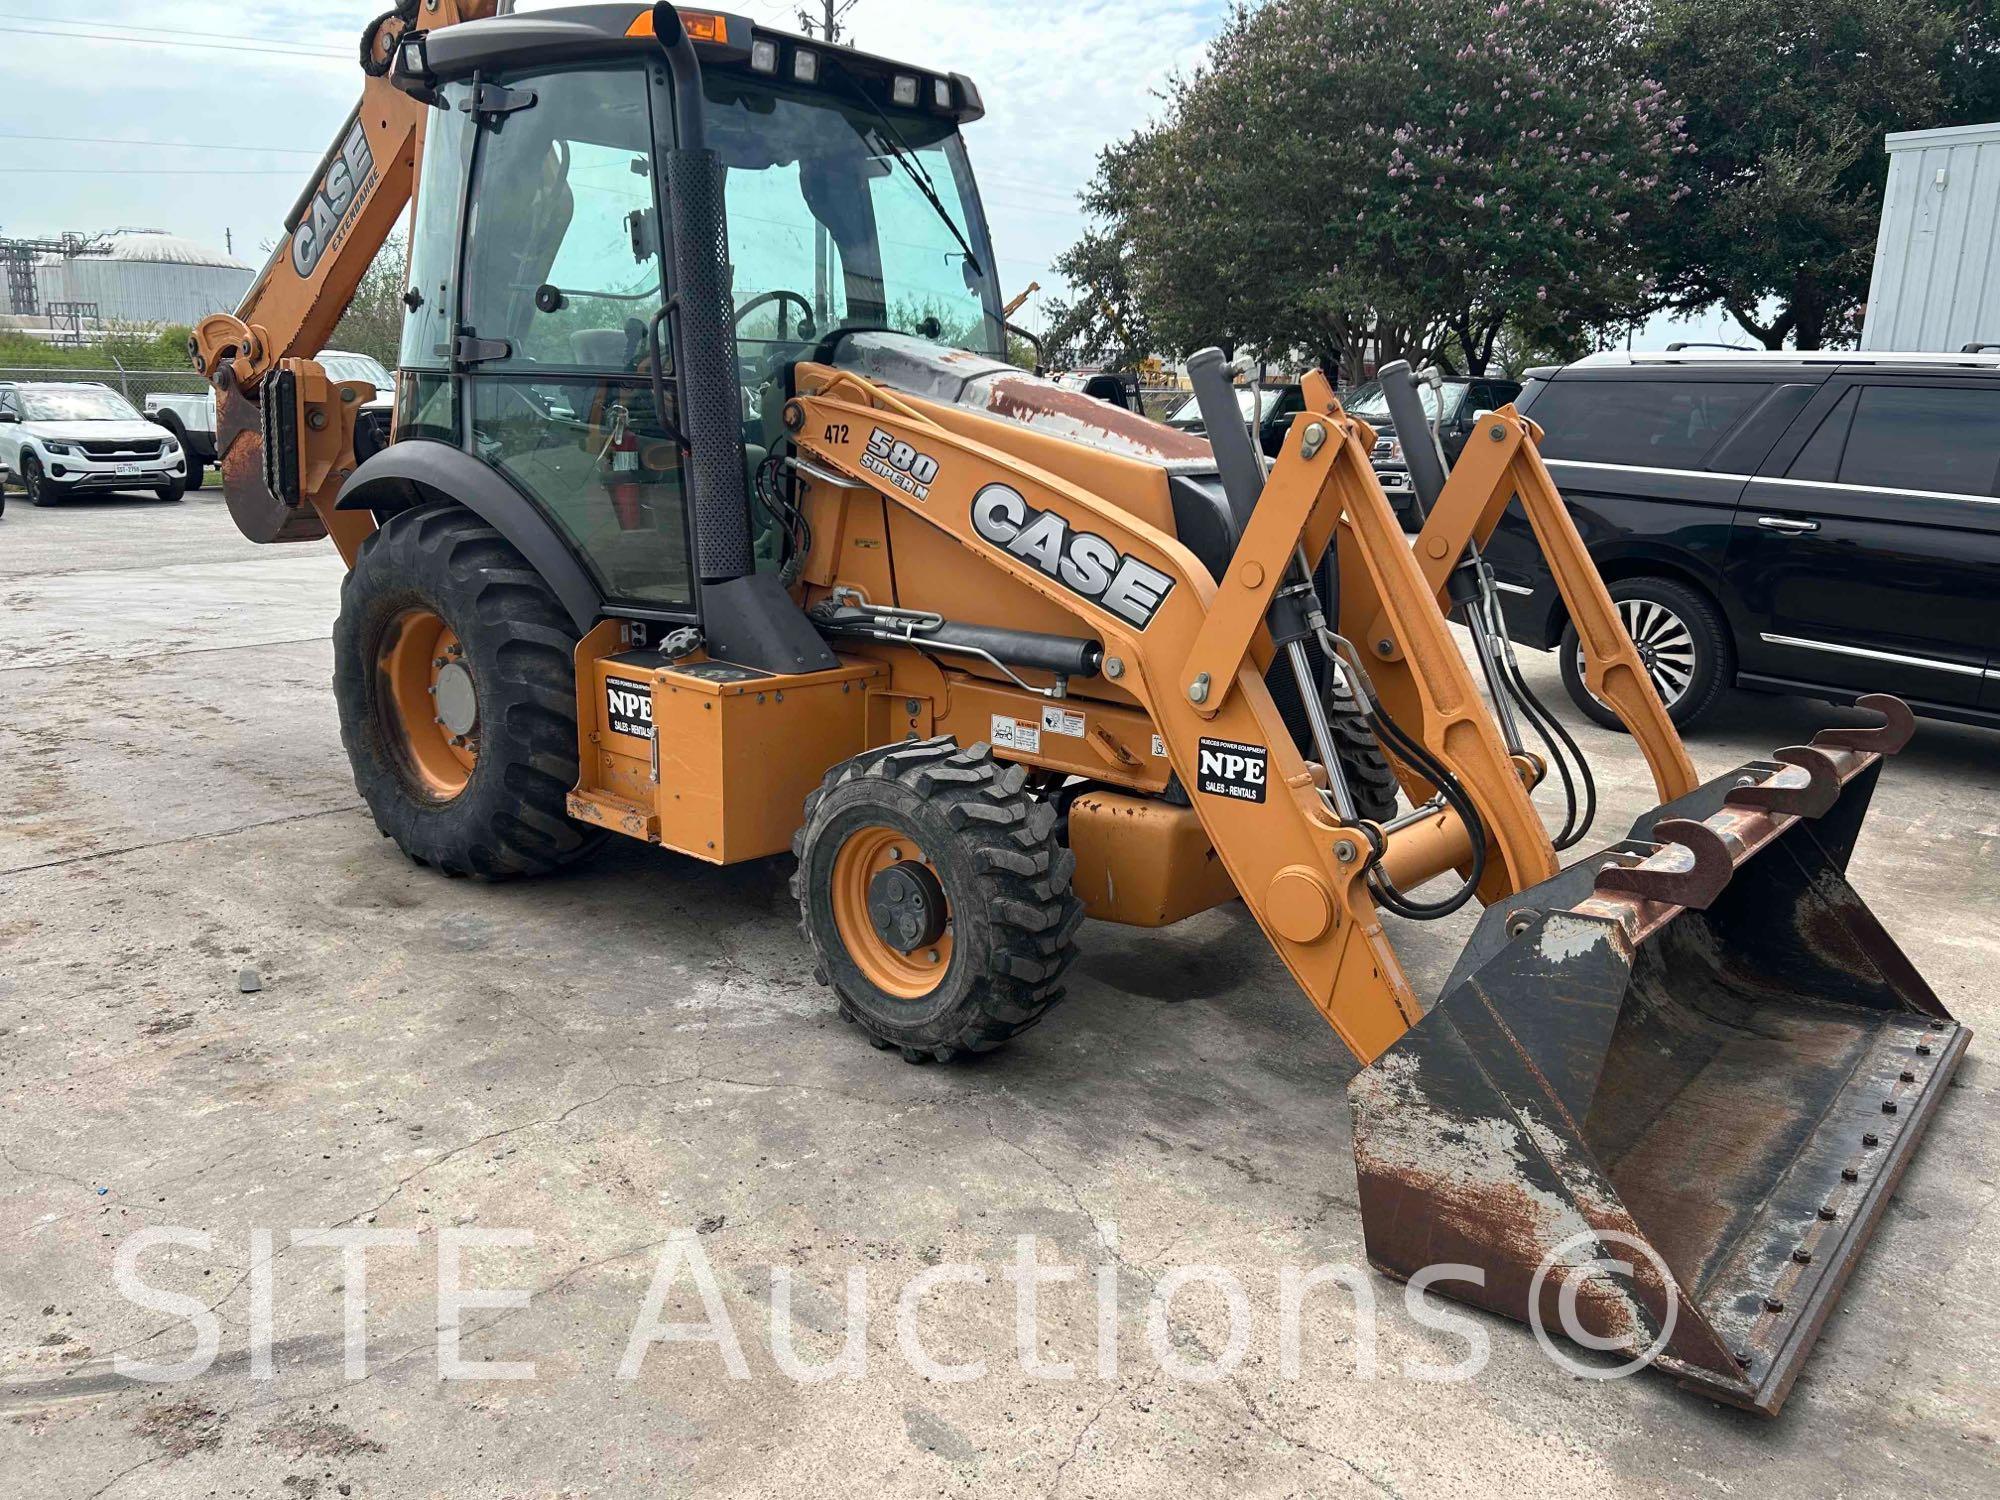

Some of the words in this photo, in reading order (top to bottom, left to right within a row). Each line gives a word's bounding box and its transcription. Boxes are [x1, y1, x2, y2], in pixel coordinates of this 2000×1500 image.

[292, 117, 374, 278] CASE
[332, 167, 380, 252] EXTENDAHOE
[824, 424, 849, 444] 472
[866, 426, 940, 485] 580
[861, 452, 915, 493] SUPER
[913, 483, 930, 501] N
[971, 483, 1177, 632] CASE
[607, 688, 653, 721] NPE
[614, 720, 628, 732] SALES
[1220, 742, 1238, 750] POWER
[1238, 745, 1266, 755] EQUIPMENT
[1200, 749, 1265, 785] NPE
[1205, 781, 1225, 793] SALES
[1229, 786, 1257, 800] RENTALS
